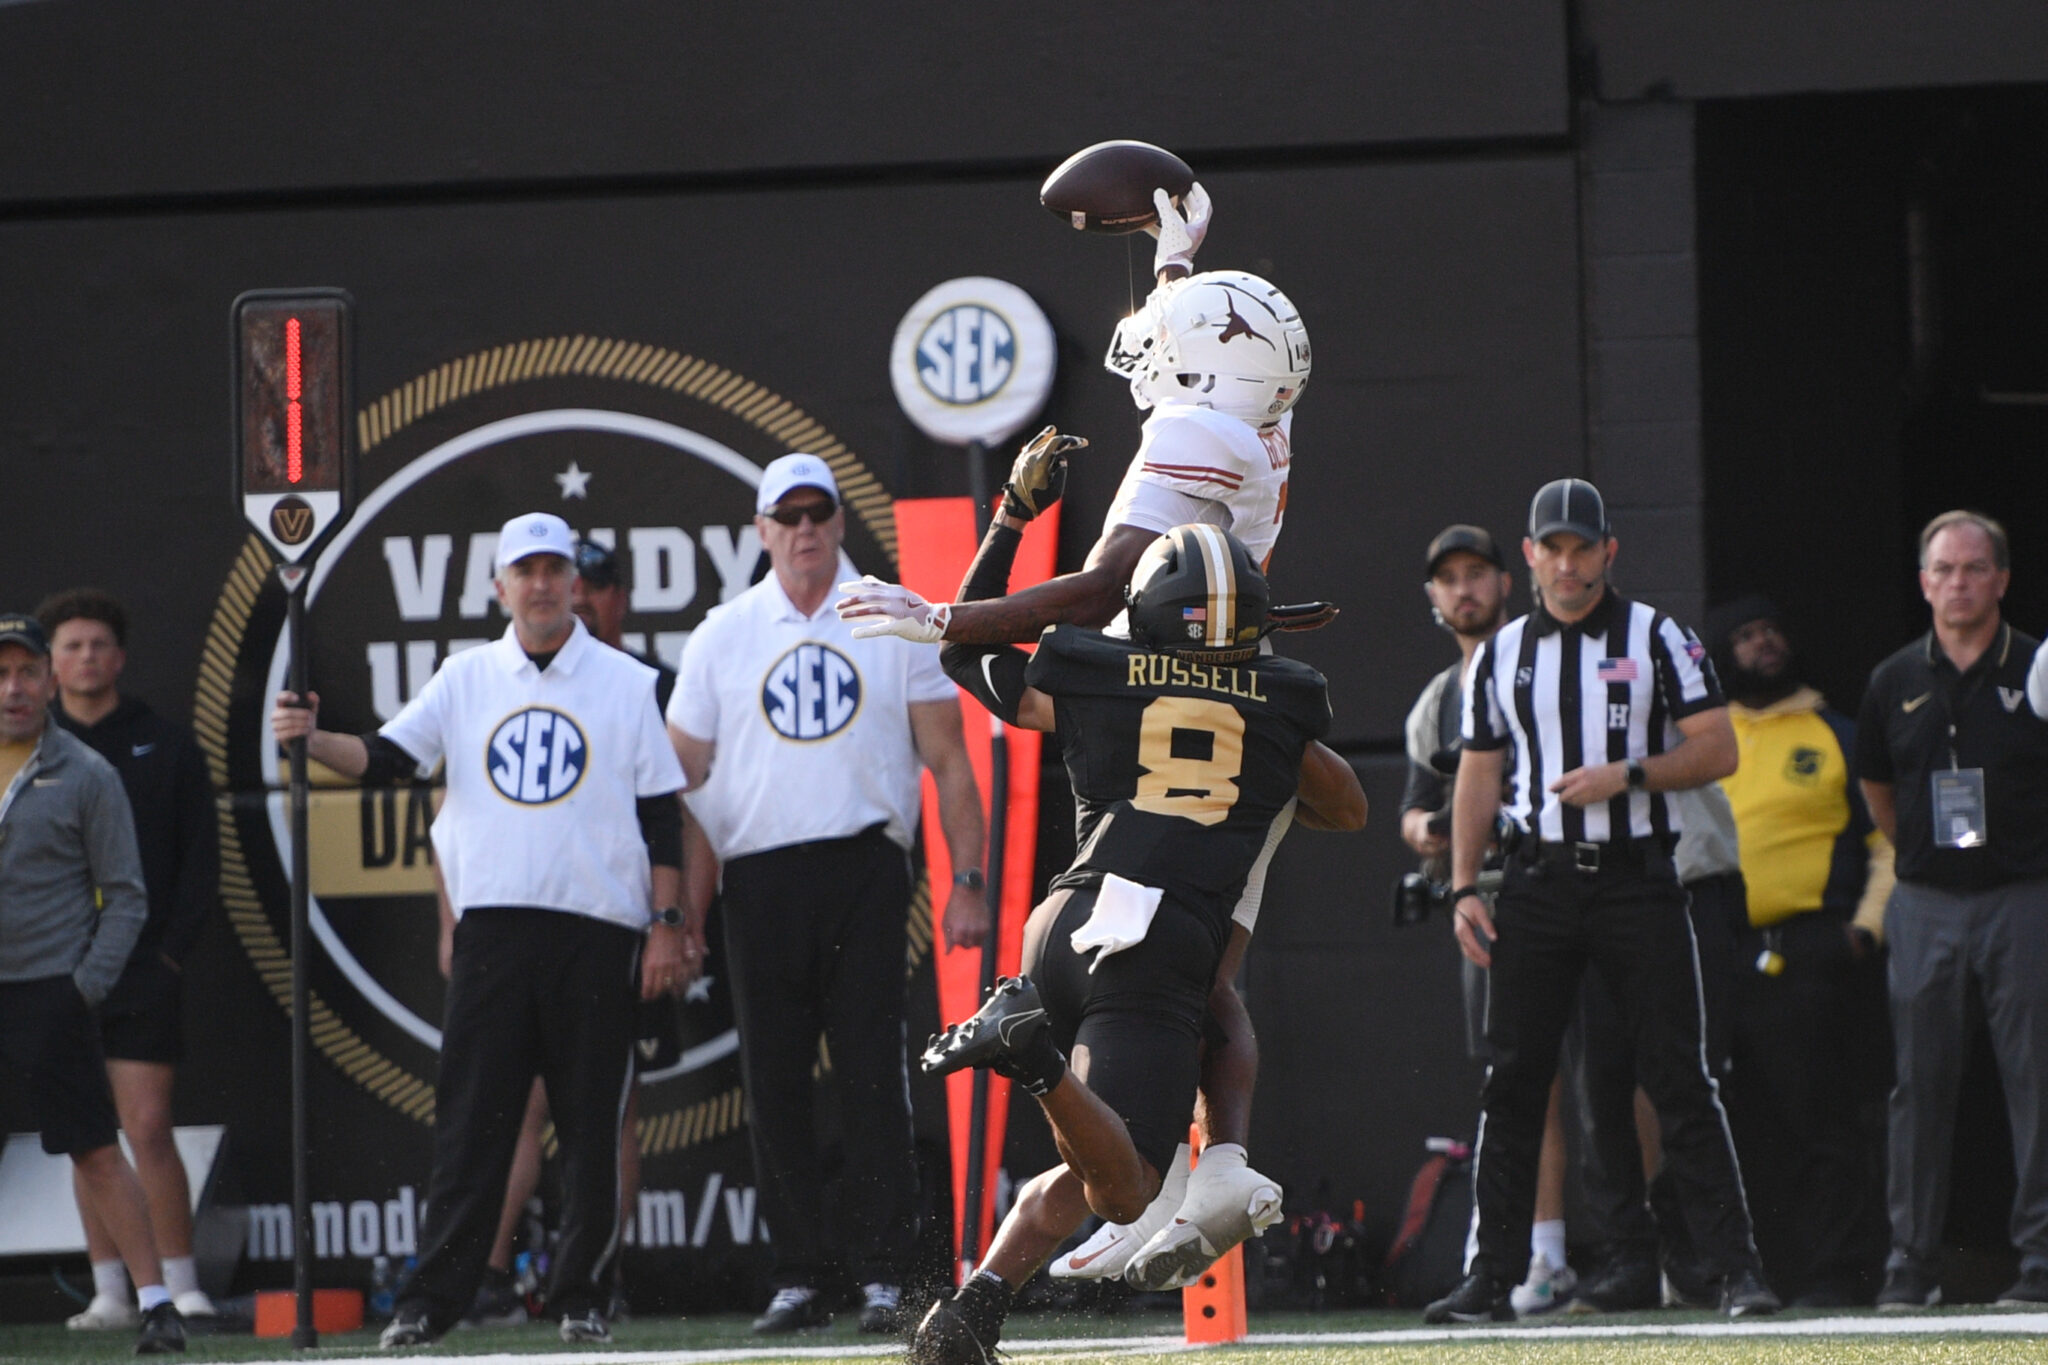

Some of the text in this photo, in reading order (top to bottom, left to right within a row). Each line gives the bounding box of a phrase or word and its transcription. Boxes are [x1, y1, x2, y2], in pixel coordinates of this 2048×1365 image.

[918, 307, 1012, 401] SEC
[274, 509, 310, 543] V
[1187, 623, 1203, 639] SEC
[765, 645, 857, 739] SEC
[1127, 653, 1268, 702] RUSSELL
[1608, 703, 1629, 730] H
[488, 708, 588, 803] SEC
[1128, 696, 1246, 826] 8
